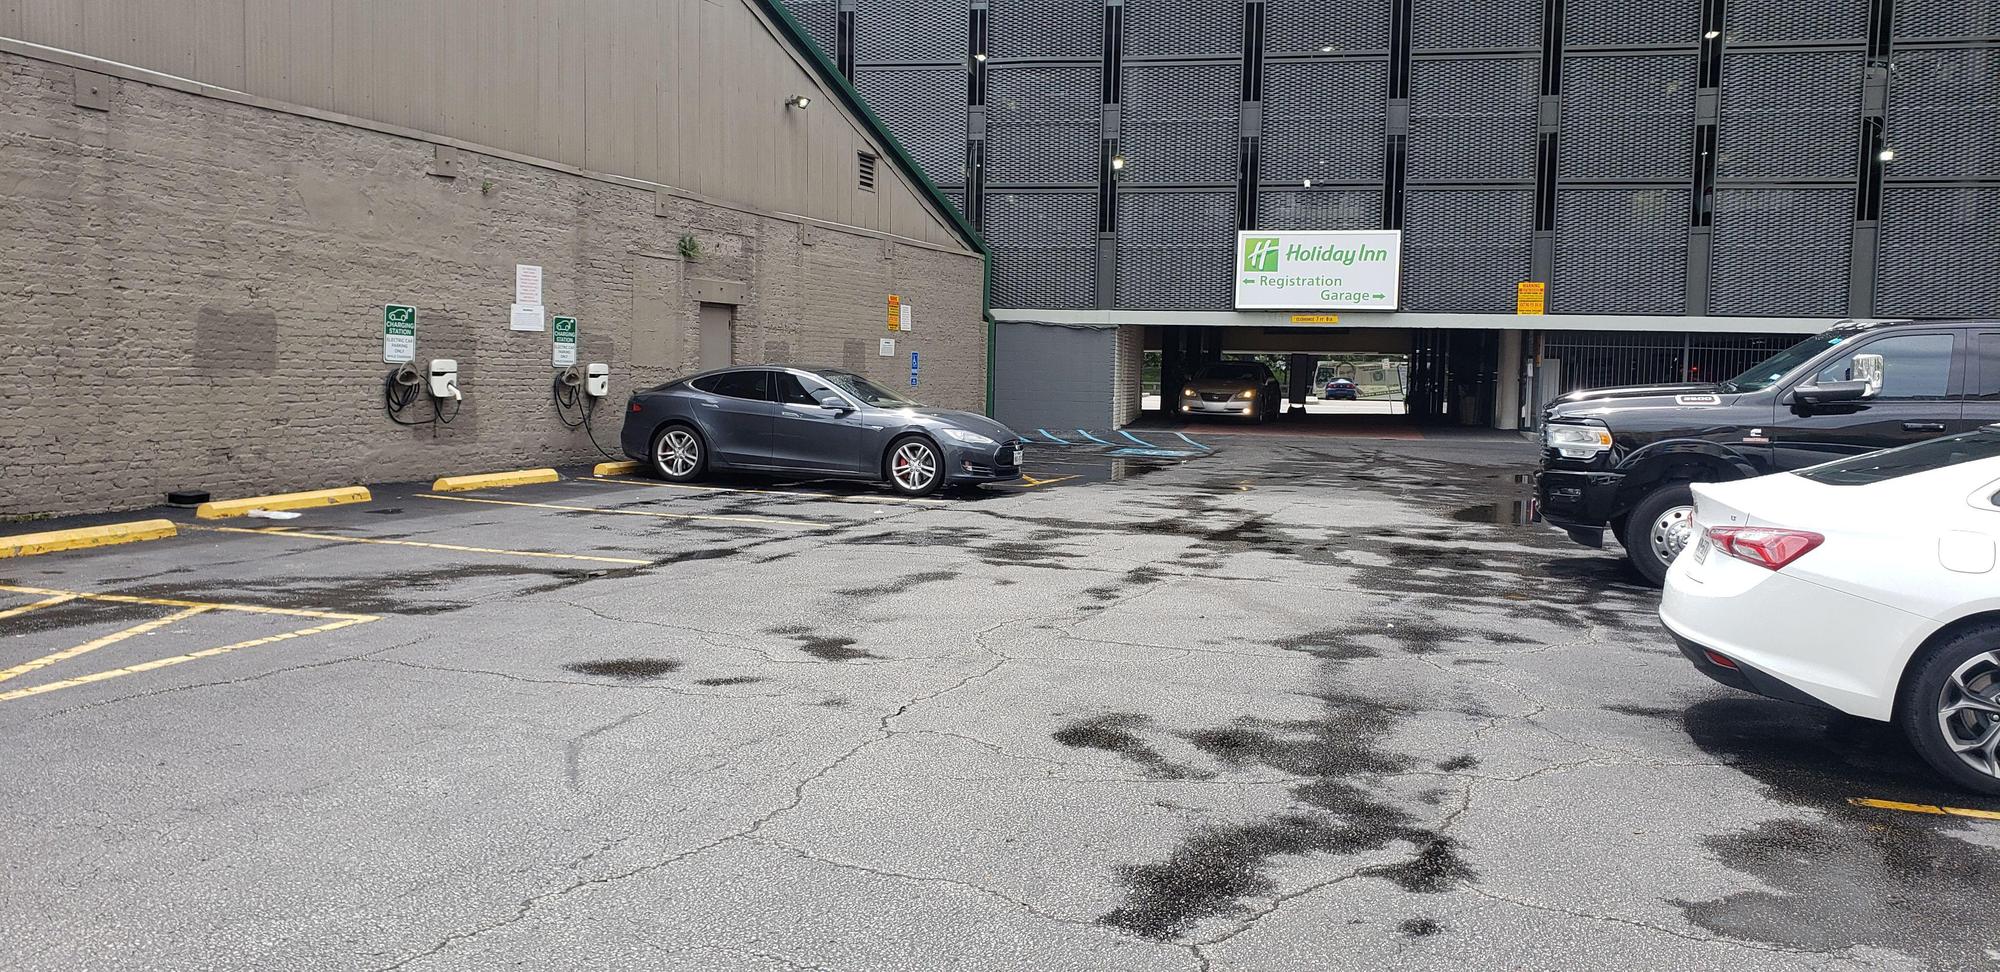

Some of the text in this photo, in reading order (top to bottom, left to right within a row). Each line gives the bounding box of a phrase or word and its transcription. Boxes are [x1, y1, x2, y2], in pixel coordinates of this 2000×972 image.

[1286, 244, 1387, 265] Holiday Inn
[1260, 275, 1342, 288] Registration
[1320, 290, 1370, 303] Garage
[386, 321, 414, 329] CHARGING
